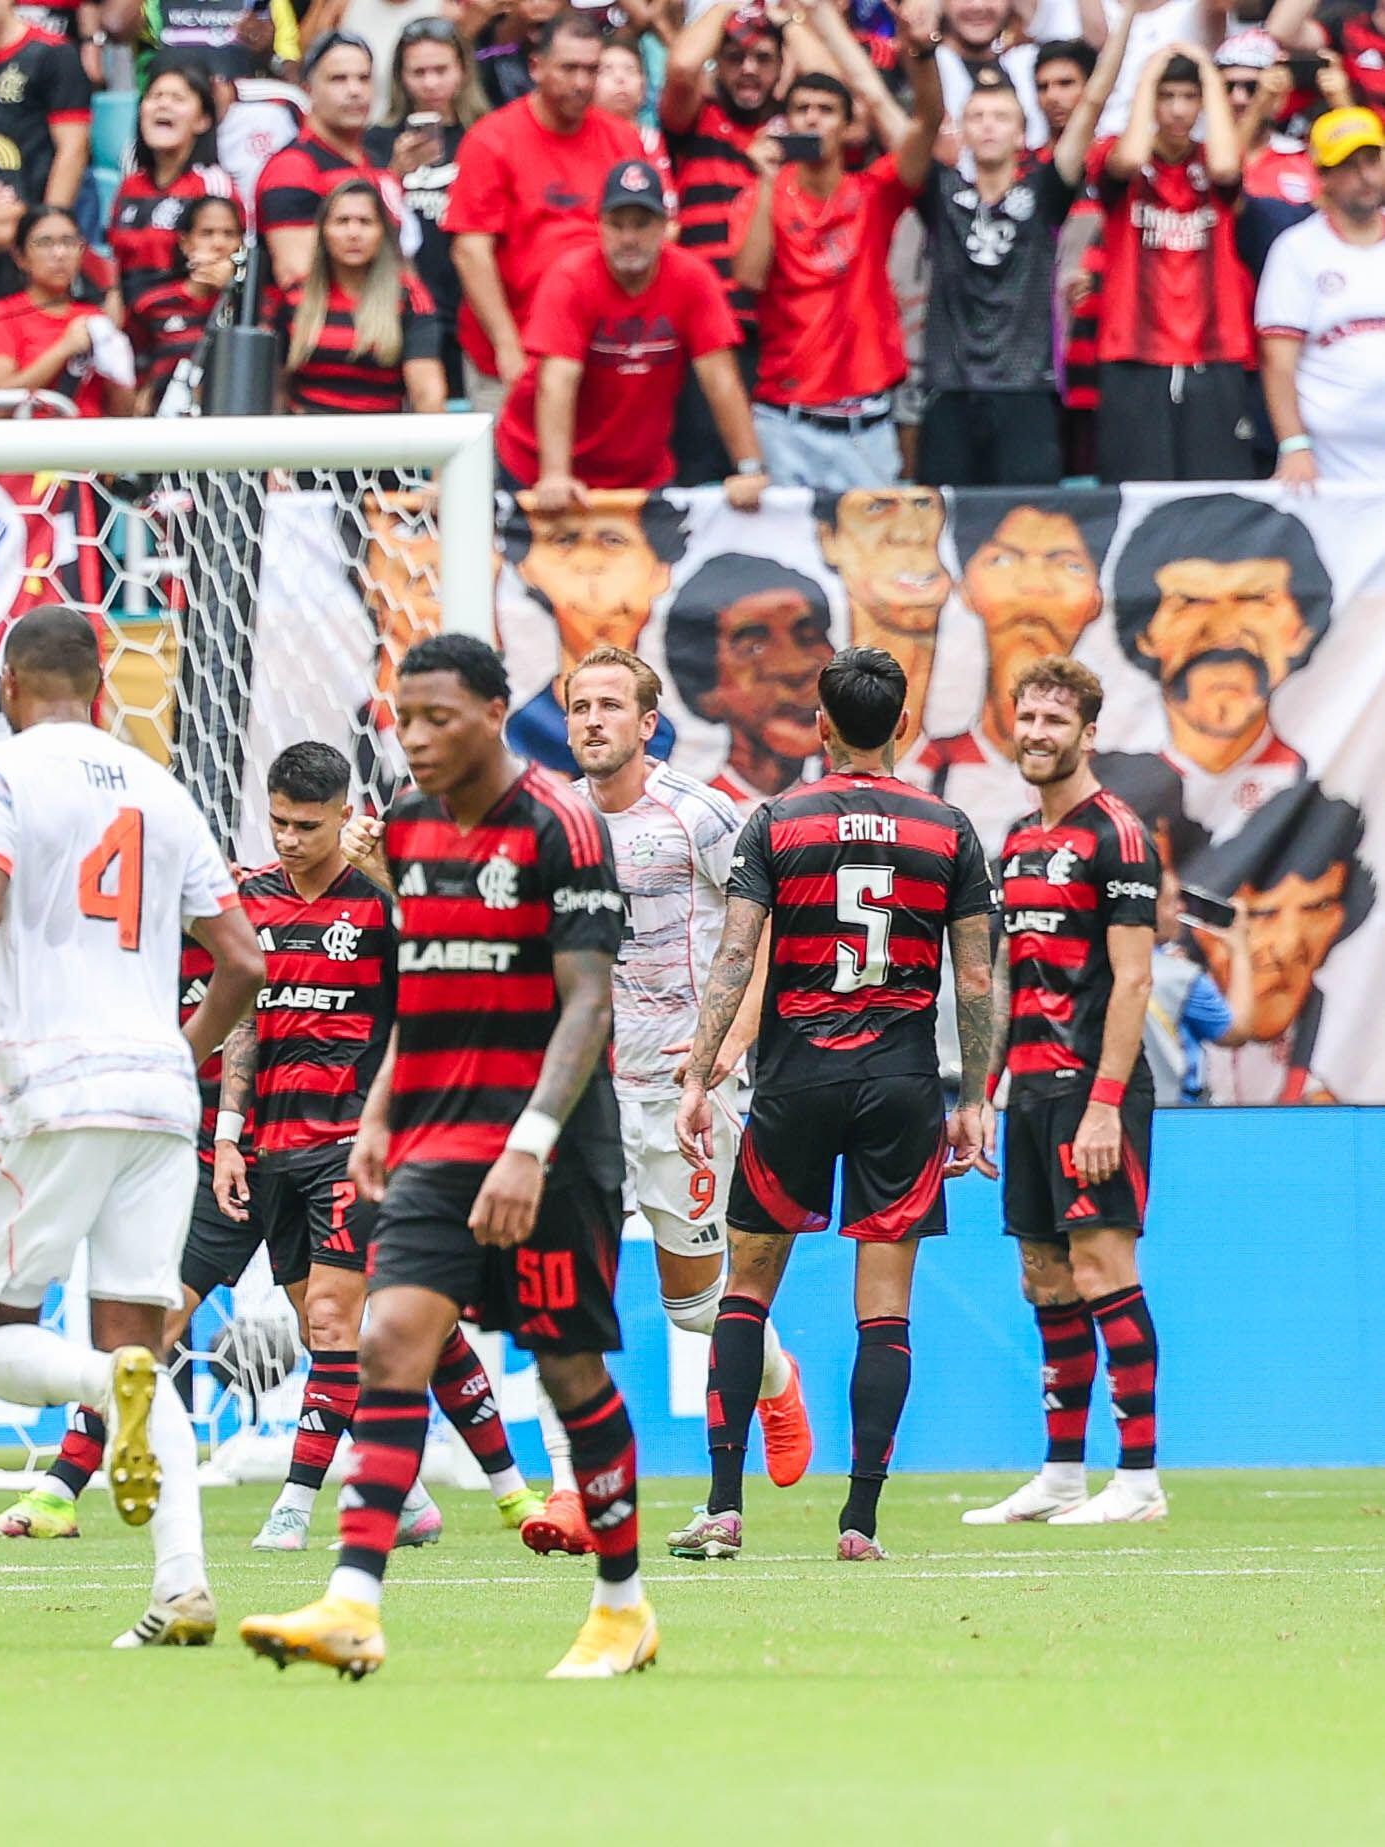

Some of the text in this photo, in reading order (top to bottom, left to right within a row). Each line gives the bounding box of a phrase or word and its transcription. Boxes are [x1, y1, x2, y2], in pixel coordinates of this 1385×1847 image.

[78, 758, 137, 790] TAH
[837, 813, 897, 843] ERICH
[78, 807, 144, 952] 4
[1106, 879, 1158, 900] Shopee
[830, 864, 896, 994] 5
[688, 1169, 716, 1220] 9
[517, 1247, 579, 1310] 50
